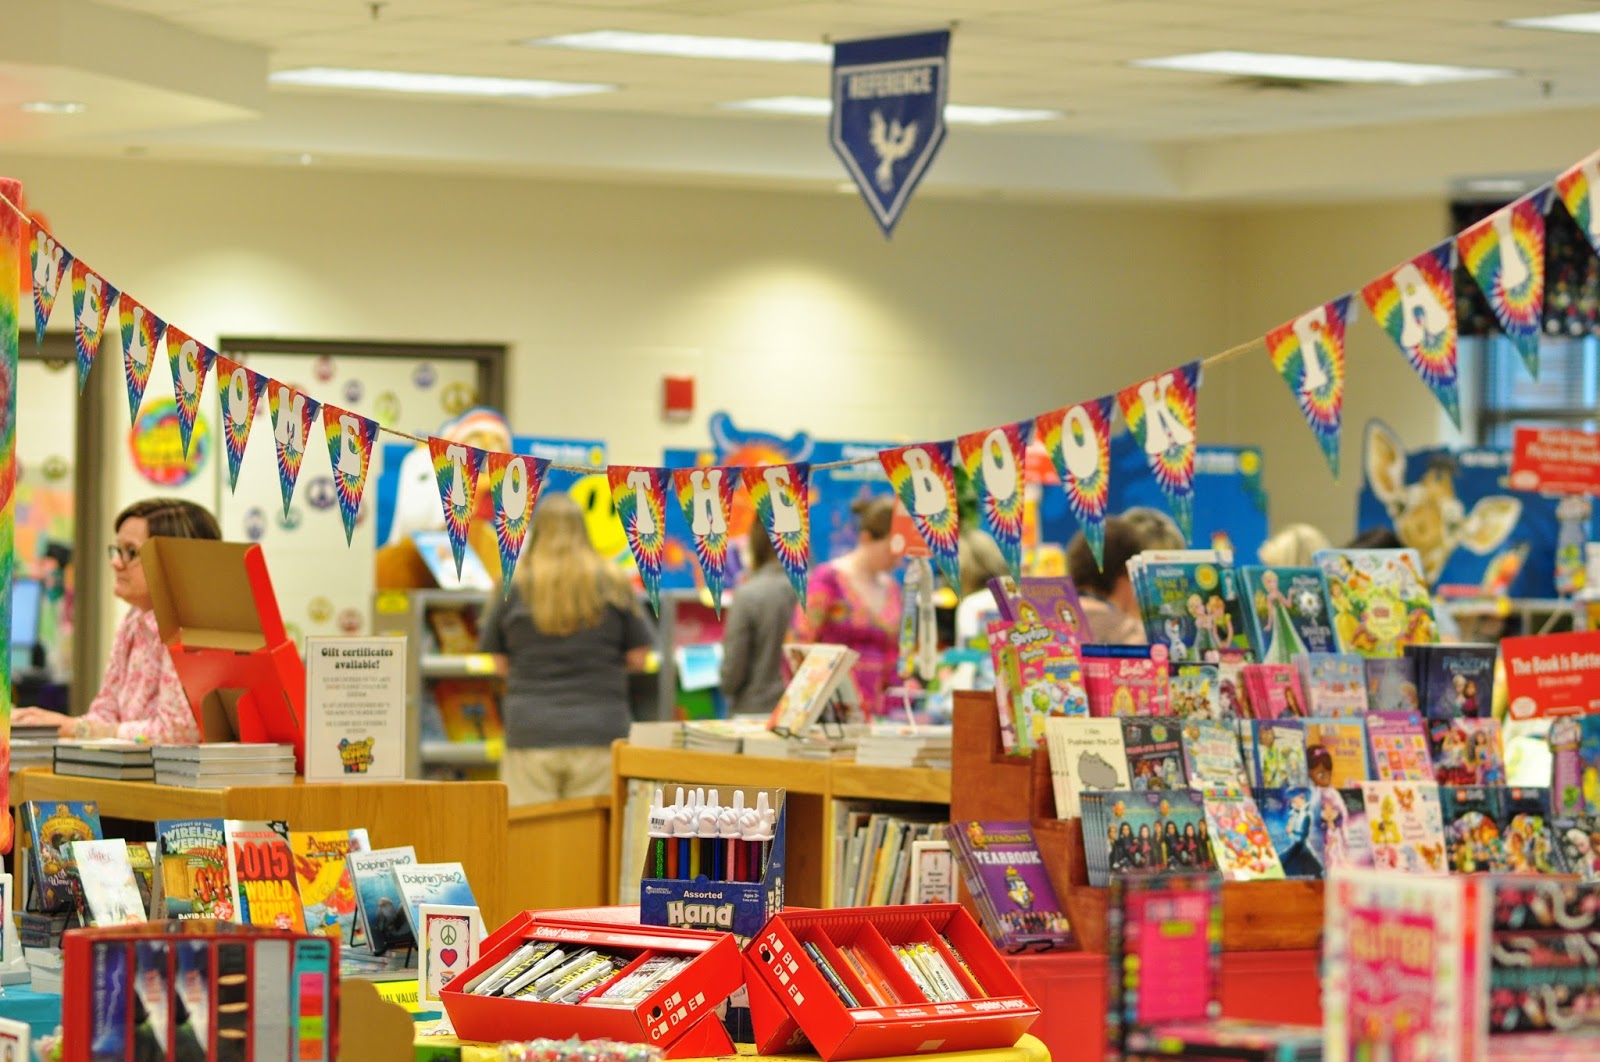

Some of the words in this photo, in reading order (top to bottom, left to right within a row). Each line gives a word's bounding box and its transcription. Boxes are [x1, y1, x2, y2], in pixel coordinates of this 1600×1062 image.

[848, 67, 932, 99] REFERENCE
[36, 230, 362, 477] WELCOME
[446, 443, 528, 520] TO
[626, 465, 802, 535] THE
[902, 372, 1195, 517] BOOK
[321, 647, 340, 657] Gift
[342, 647, 394, 657] certificates
[335, 660, 380, 670] available!
[1511, 656, 1531, 676] The
[1532, 653, 1560, 674] Book
[162, 826, 223, 842] WIRELESS
[169, 838, 219, 854] WEENIES
[233, 840, 289, 878] 2015
[356, 858, 388, 872] Dolphin
[972, 851, 1042, 865] YEARBOOK
[402, 874, 438, 885] Dolphin
[435, 873, 455, 887] Tale
[454, 872, 464, 884] 2
[244, 880, 293, 901] WORLD
[683, 890, 723, 899] Assorted
[667, 901, 734, 928] Hand
[533, 926, 560, 937] School
[558, 928, 591, 941] Supplies
[766, 932, 777, 945] A
[782, 951, 792, 965] B
[773, 963, 783, 976] D
[787, 983, 798, 997] E
[664, 998, 674, 1011] B
[688, 997, 698, 1011] E
[647, 1013, 656, 1027] A
[670, 1012, 680, 1026] D
[651, 1028, 661, 1040] C
